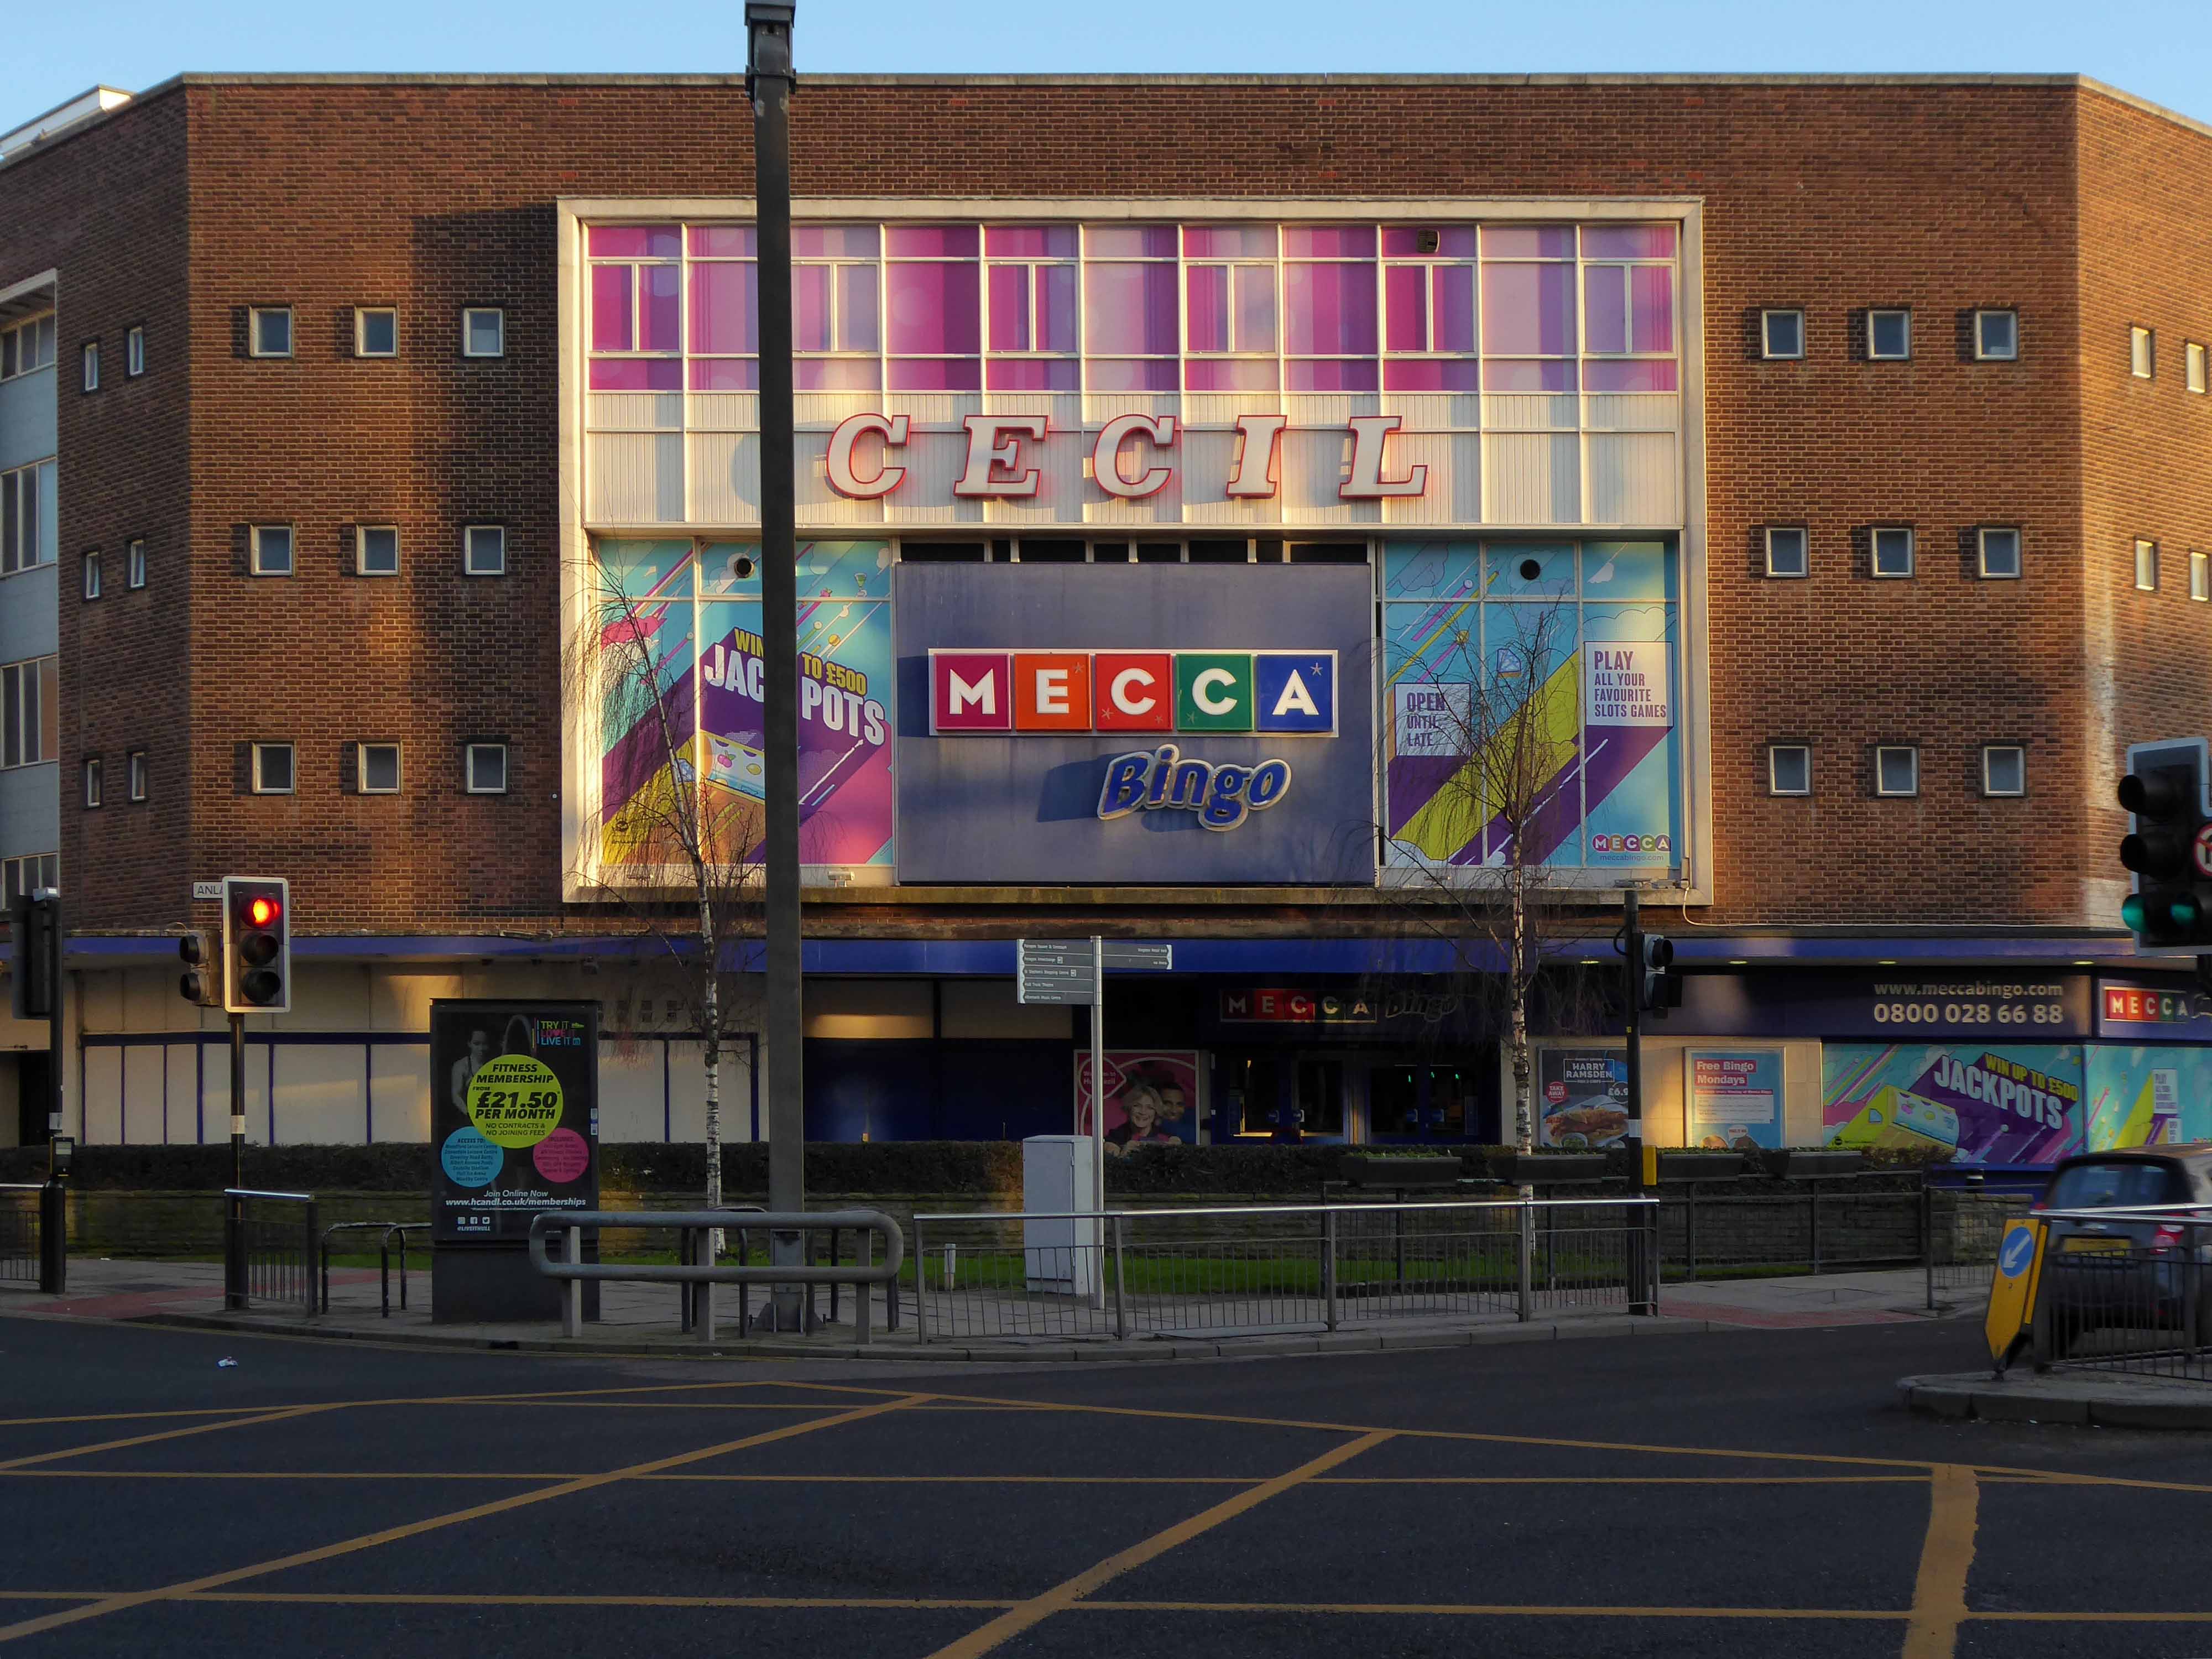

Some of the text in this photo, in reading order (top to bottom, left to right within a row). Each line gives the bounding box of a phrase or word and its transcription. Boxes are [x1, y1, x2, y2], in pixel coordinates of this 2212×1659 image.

[825, 412, 1428, 500] CECIL
[1594, 650, 1634, 670] PLAY
[802, 653, 822, 679] TO
[826, 662, 867, 695] £500
[1594, 673, 1645, 686] ALL YOUR
[704, 644, 885, 746] JACPOTS
[948, 667, 1321, 717] MECCA
[1594, 688, 1651, 702] FAVOURITE
[1407, 692, 1446, 711] OPEN
[1594, 704, 1666, 718] SLOTS GAMES
[1407, 715, 1438, 729] UNTIL
[1407, 733, 1433, 747] LATE
[1097, 744, 1292, 832] Bingo
[1594, 836, 1670, 850] MECCA
[1873, 980, 2064, 999] www.meccabingo.com
[1227, 995, 1370, 1015] MECCA
[2112, 995, 2188, 1016] MECCA
[1873, 1003, 2064, 1024] 0800 028 66 88
[540, 1020, 559, 1030] TRY
[541, 1036, 562, 1046] LIVE
[492, 1064, 538, 1072] FITNESS
[1697, 1061, 1755, 1072] Free Bingo
[476, 1074, 554, 1083] MEMBERSHIP
[1697, 1075, 1745, 1086] Mondays
[1985, 1053, 2079, 1102] WIN UP TO £500
[1933, 1055, 2063, 1130] JACKPOTS
[475, 1109, 556, 1119] PER MONTH
[483, 1190, 500, 1198] Join
[445, 1198, 587, 1208] www.hcandl.co.uk/memberships
